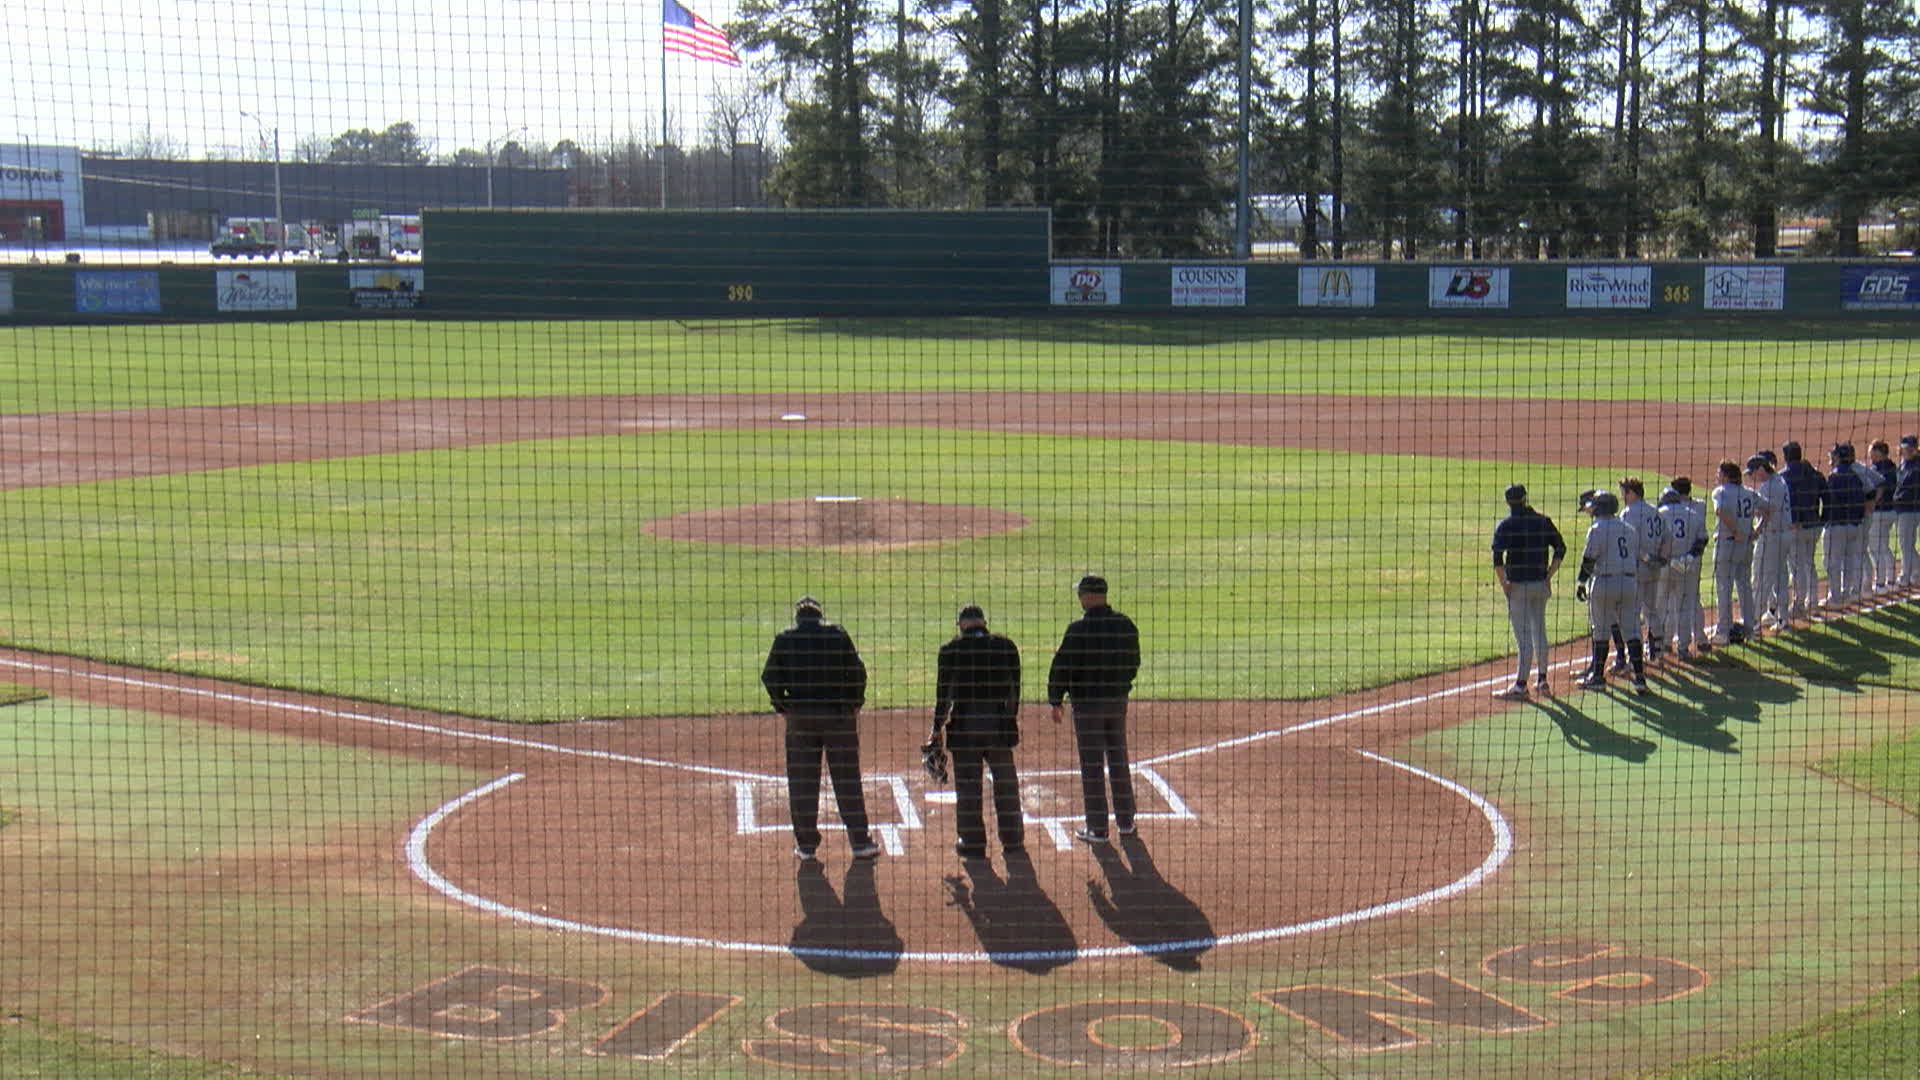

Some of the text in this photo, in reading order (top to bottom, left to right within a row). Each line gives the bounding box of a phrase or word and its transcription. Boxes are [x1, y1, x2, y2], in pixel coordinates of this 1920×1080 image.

[1178, 269, 1235, 284] COUSINS
[728, 285, 753, 301] 390
[1569, 279, 1648, 293] RiverWind
[1663, 286, 1689, 302] 365
[1610, 295, 1648, 305] BANK
[1737, 498, 1752, 518] 12
[1647, 515, 1662, 539] 33
[1674, 518, 1686, 539] 3
[1617, 536, 1629, 559] 6
[344, 940, 1709, 1071] BISONS
